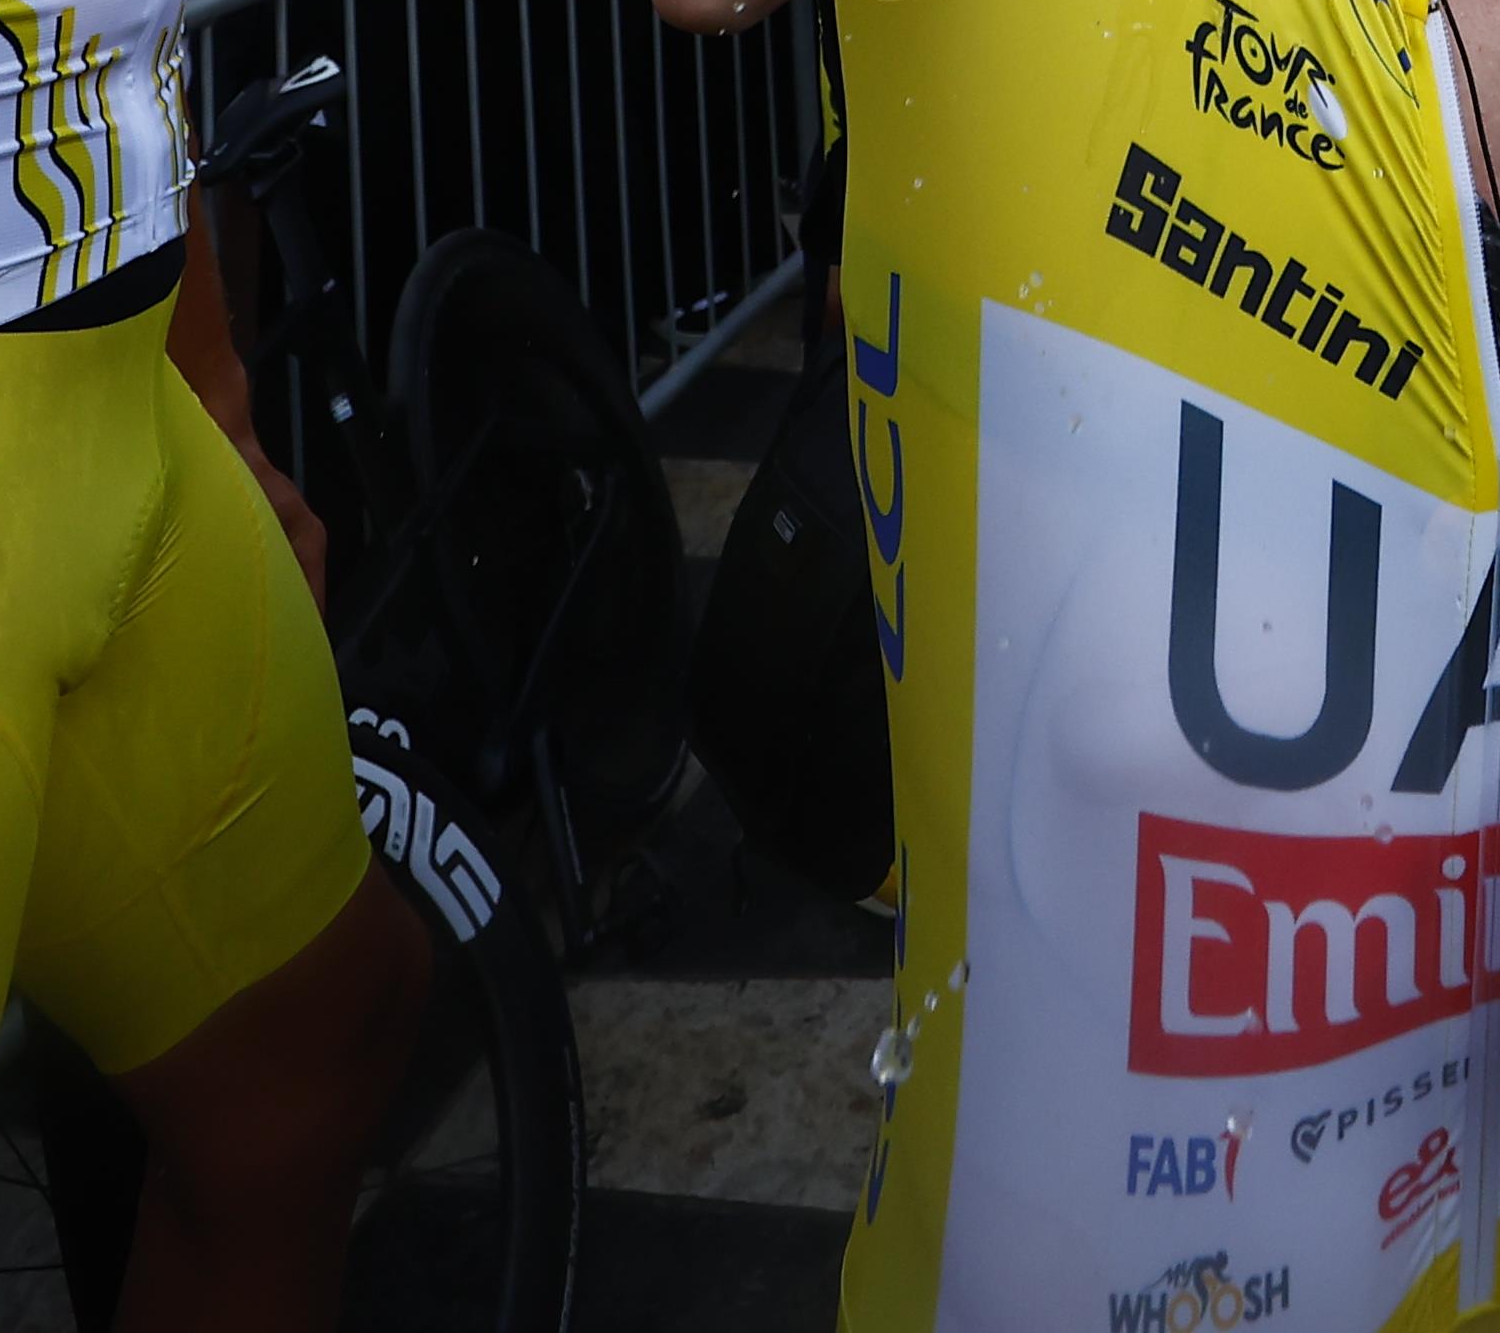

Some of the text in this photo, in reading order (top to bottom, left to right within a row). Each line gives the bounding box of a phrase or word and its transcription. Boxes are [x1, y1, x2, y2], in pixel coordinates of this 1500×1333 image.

[1285, 91, 1308, 119] de
[1105, 141, 1425, 402] Santini
[1337, 1057, 1470, 1140] PISSEI
[1126, 1135, 1217, 1197] FAB
